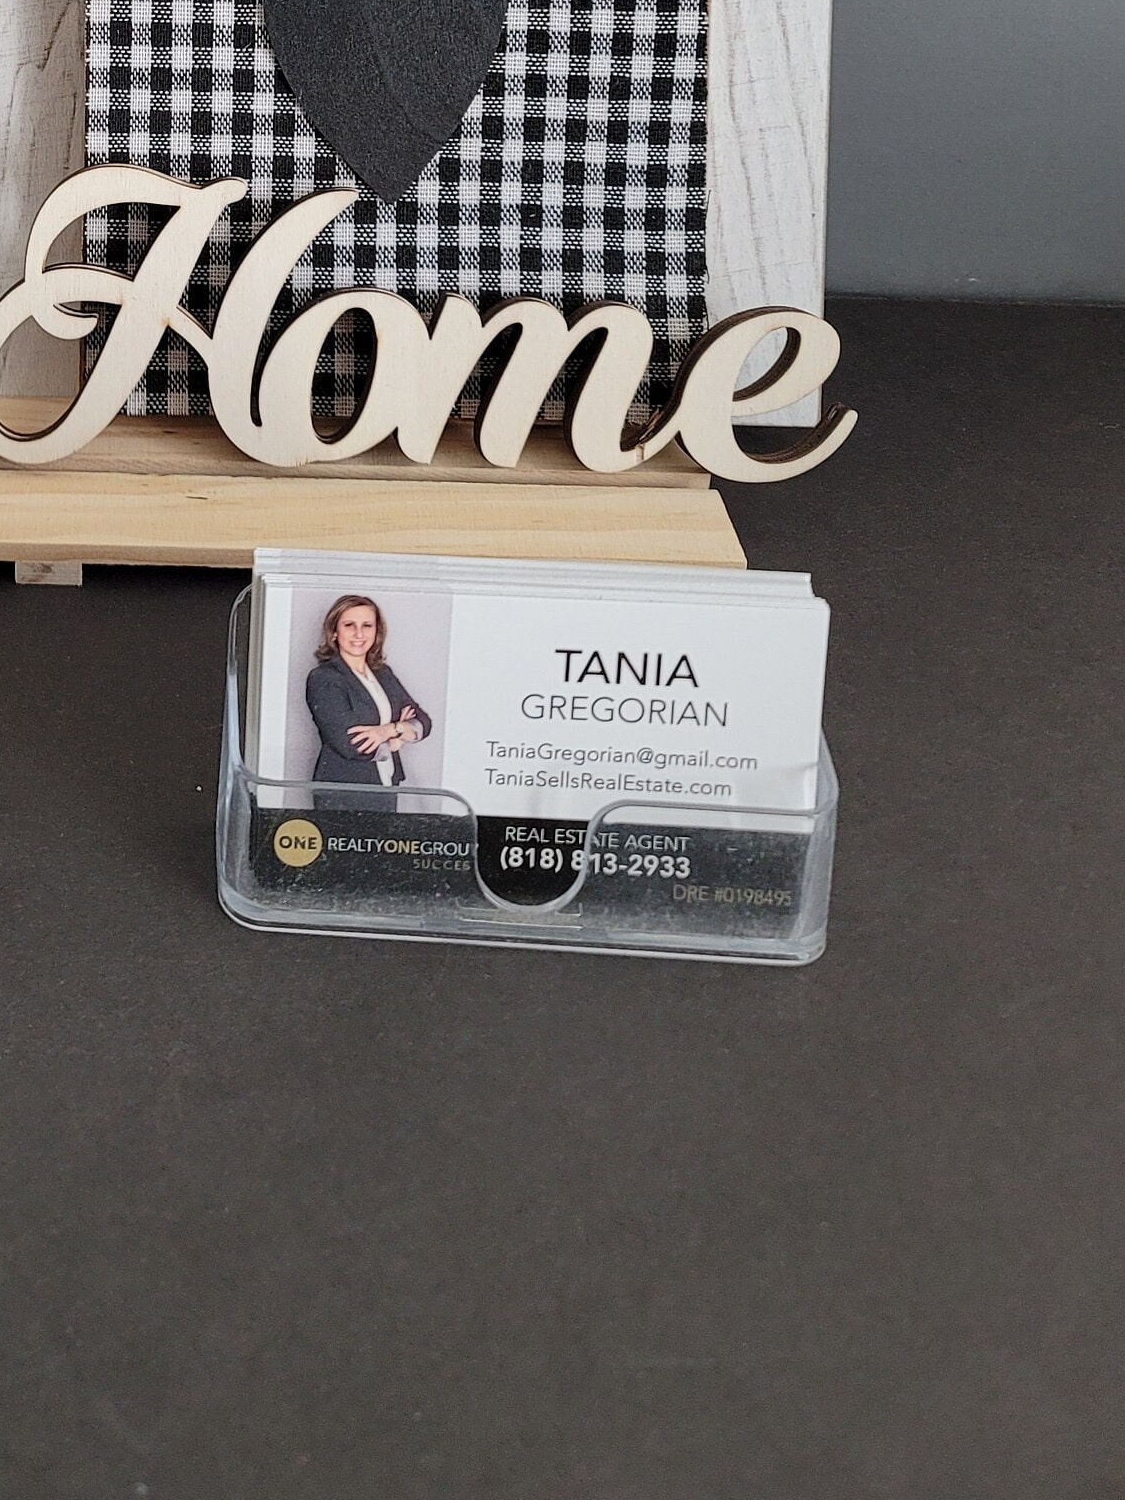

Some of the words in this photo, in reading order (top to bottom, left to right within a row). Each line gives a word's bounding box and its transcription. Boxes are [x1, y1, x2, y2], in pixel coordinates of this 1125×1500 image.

[555, 648, 700, 689] TANIA
[520, 693, 729, 728] GREGORIAN
[485, 740, 759, 770] TaniaGregorian@gmail.com
[484, 768, 733, 796] TaniaSellsRealEstate.com
[278, 835, 318, 851] ONE
[327, 837, 479, 856] REALTYONEGROU
[504, 826, 550, 843] REAL
[624, 834, 692, 853] AGENT
[412, 858, 477, 871] SUCCES
[499, 845, 564, 874] (818)
[570, 849, 692, 880] 813-2933
[672, 883, 711, 904] DRE
